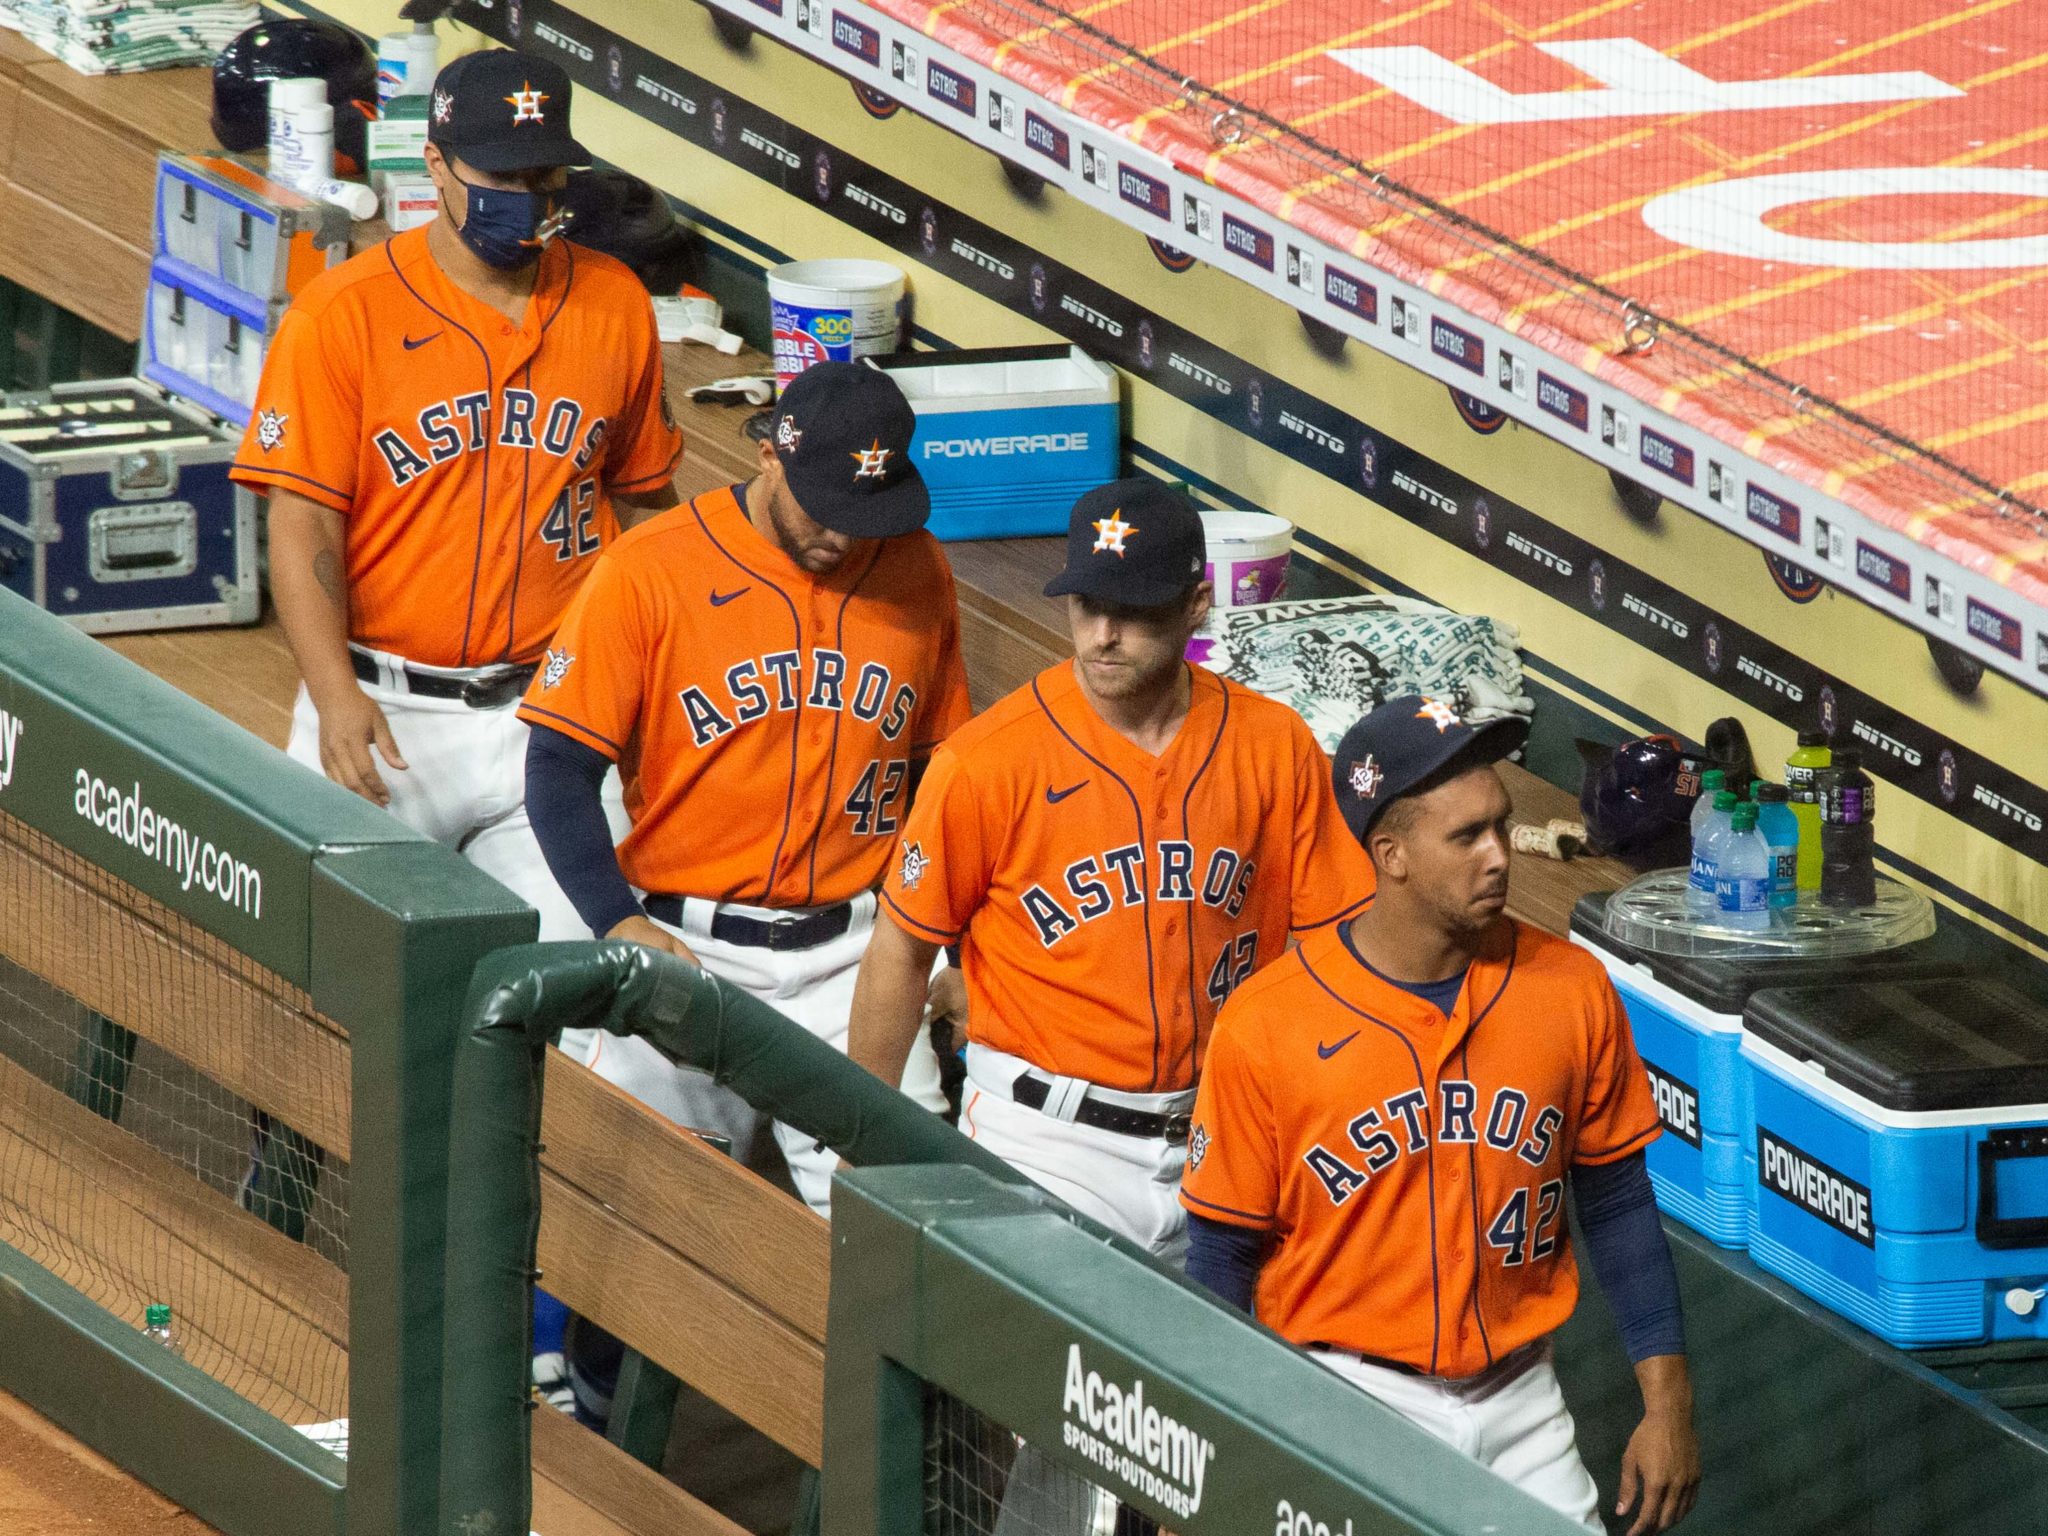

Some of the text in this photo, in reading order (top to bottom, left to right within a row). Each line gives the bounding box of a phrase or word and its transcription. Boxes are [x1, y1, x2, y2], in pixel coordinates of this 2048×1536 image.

[513, 91, 544, 120] H
[814, 317, 851, 335] 300
[1168, 352, 1231, 395] NITTO
[373, 387, 606, 488] ASTROS
[923, 432, 1089, 459] POWERADE
[1279, 410, 1345, 454] NITTO
[855, 449, 890, 478] H
[1392, 471, 1457, 515] NITTO
[539, 477, 601, 562] 42
[1094, 518, 1131, 550] H
[1506, 531, 1573, 576] NITTO
[1622, 593, 1688, 638] NITTO
[678, 648, 917, 748] ASTROS
[1736, 655, 1803, 702] NITTO
[1853, 720, 1921, 767] NITTO
[844, 759, 908, 836] 42
[1355, 770, 1371, 787] 42
[1973, 785, 2042, 832] NITTO
[75, 768, 261, 919] academy.com
[1019, 840, 1256, 949] ASTROS
[1302, 1080, 1564, 1208] ASTROS
[1763, 1137, 1870, 1238] POWERADE
[1486, 1178, 1564, 1267] 42
[1063, 1343, 1208, 1514] Academy
[1063, 1421, 1190, 1519] SPORTS+OUTDOORS
